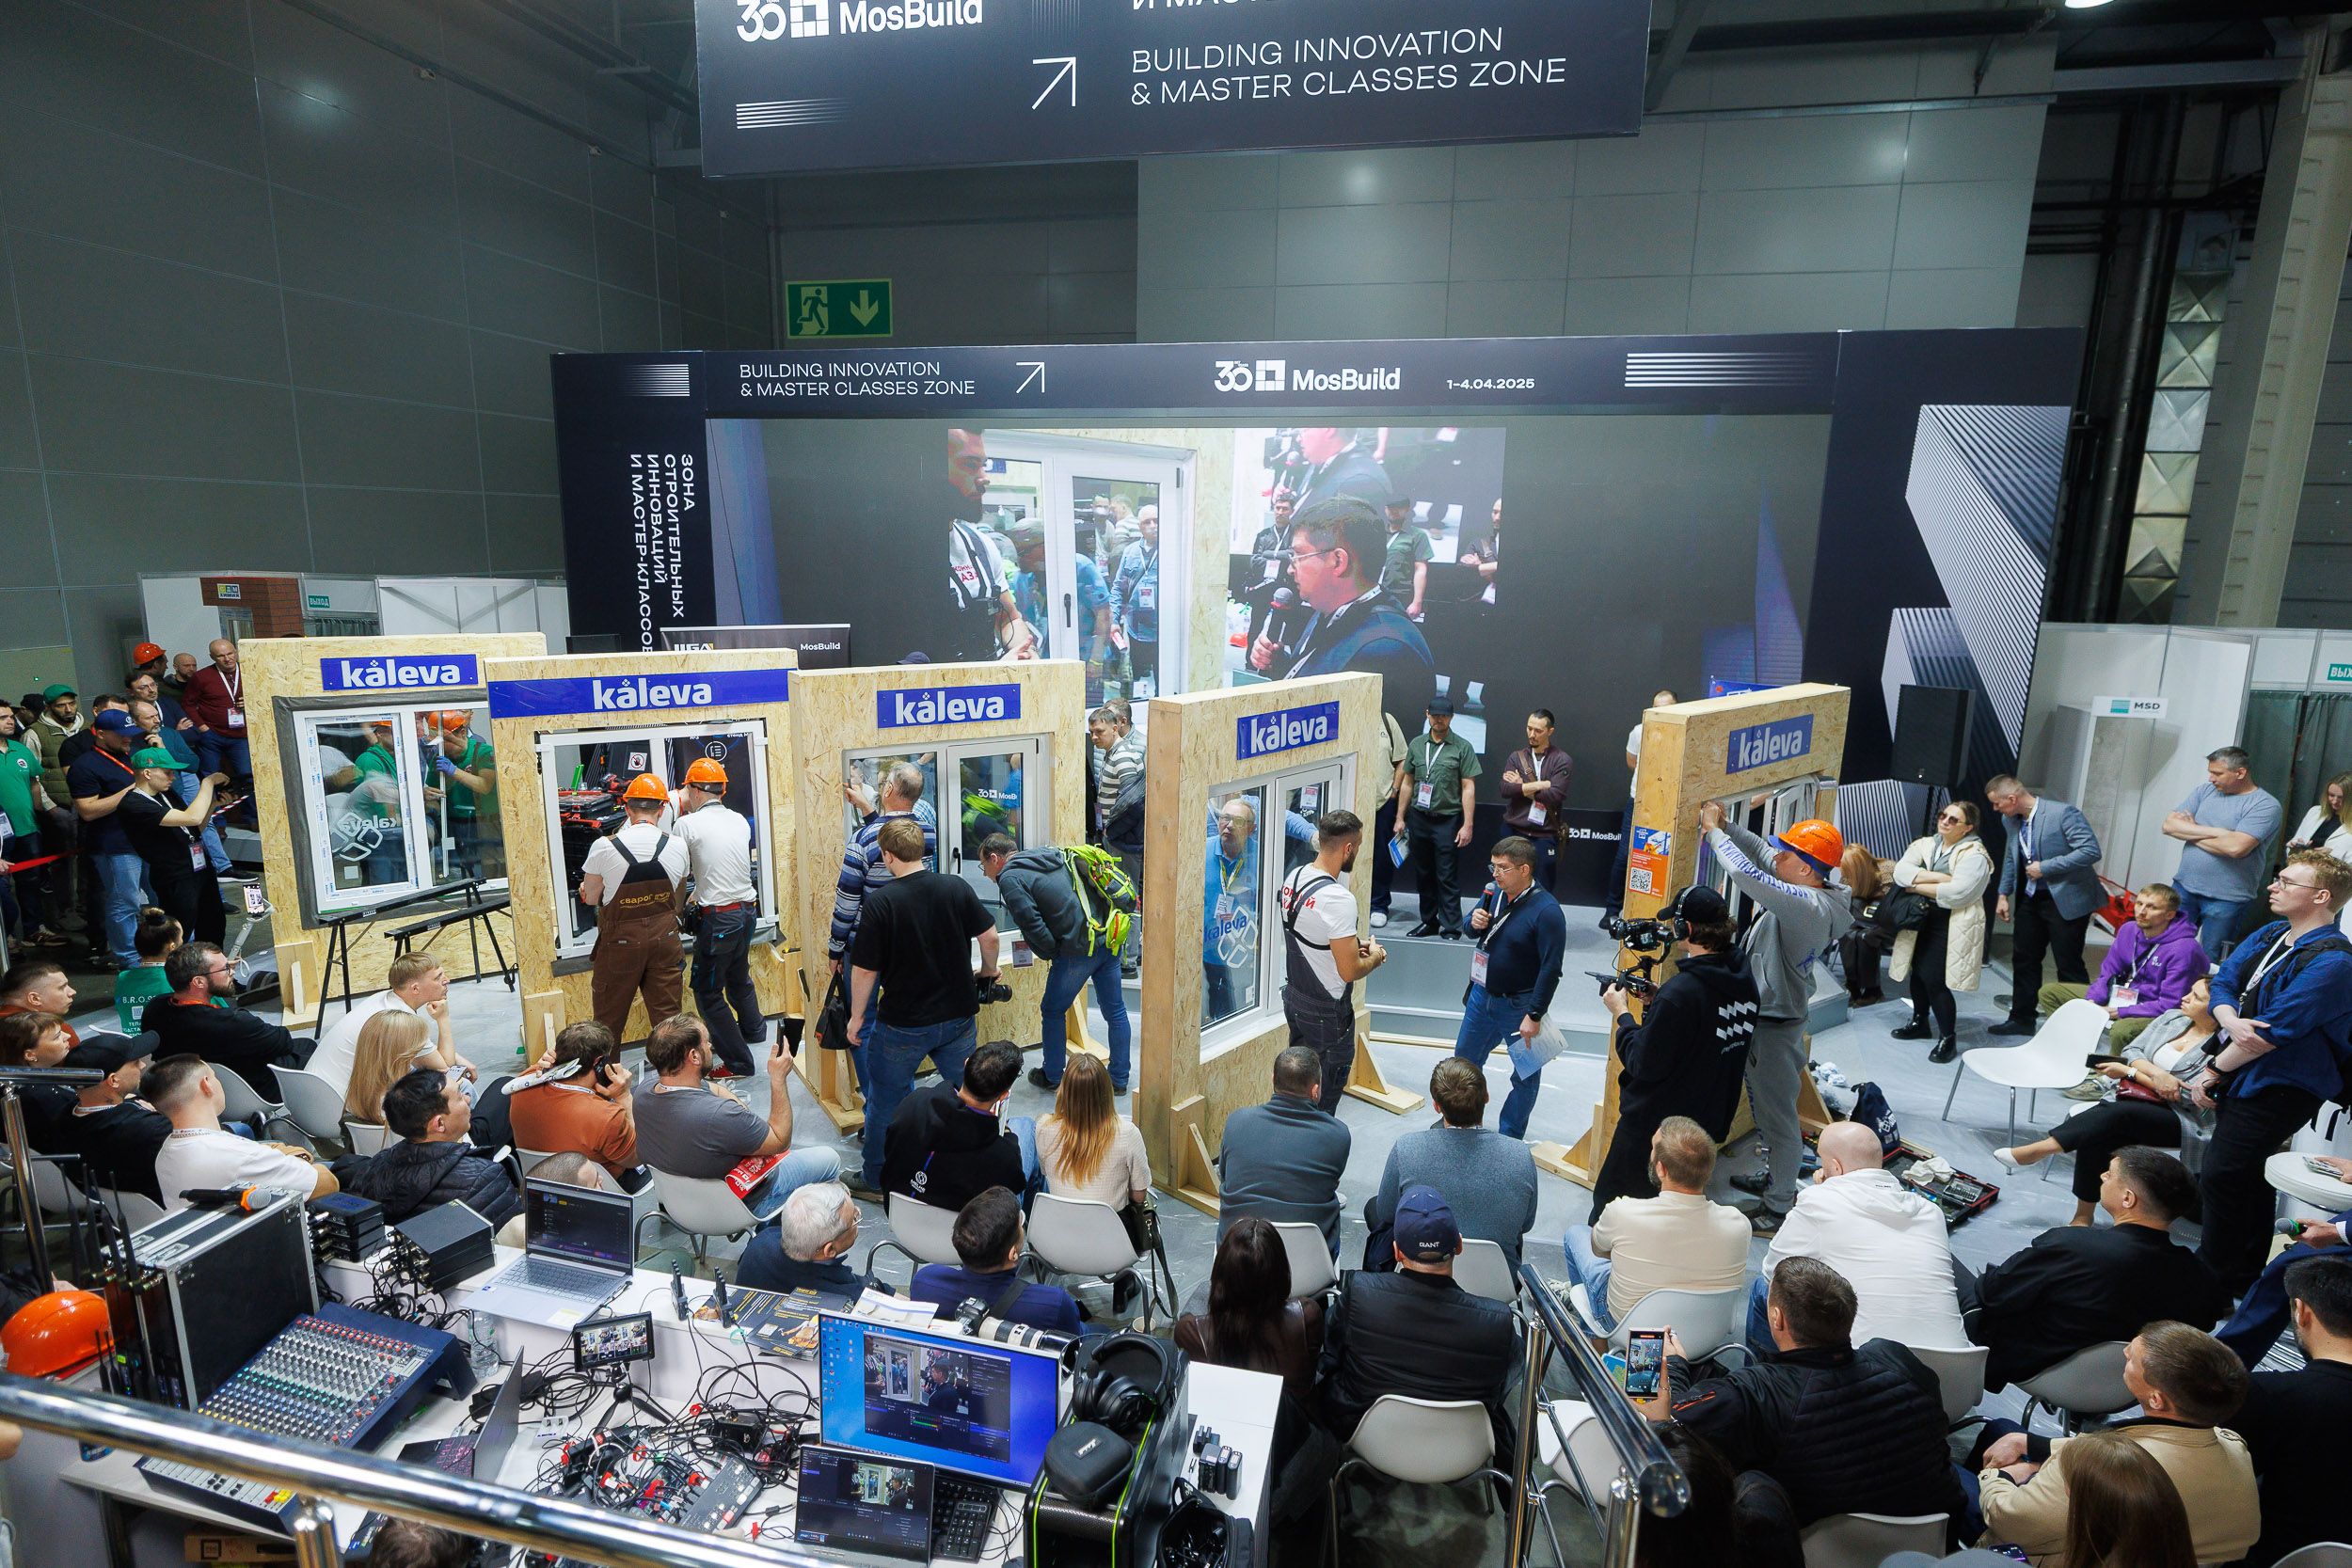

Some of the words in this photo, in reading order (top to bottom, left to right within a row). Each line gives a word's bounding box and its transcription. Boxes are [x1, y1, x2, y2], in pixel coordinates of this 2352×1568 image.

[839, 0, 983, 35] MosBuild
[1132, 41, 1282, 73] BUILDING
[1295, 26, 1502, 64] INNOVATION
[1131, 83, 1151, 105] &
[1161, 73, 1292, 103] MASTER
[1303, 64, 1457, 96] CLASSES
[1469, 58, 1566, 87] ZONE
[739, 364, 823, 378] BUILDING
[829, 362, 940, 377] INNOVATION
[1293, 367, 1401, 391] MosBuild
[740, 384, 753, 396] &
[757, 383, 829, 396] MASTER
[834, 381, 918, 396] CLASSES
[924, 380, 975, 395] ZONE
[630, 453, 642, 467] И
[681, 453, 695, 511] ЗОНА
[646, 453, 669, 583] ИННОВАЦИЙ
[664, 453, 685, 618] СТРОИТЕЛЬНЫХ
[800, 641, 841, 651] MosBuild
[2134, 702, 2160, 710] MSD
[619, 894, 654, 905] сварог
